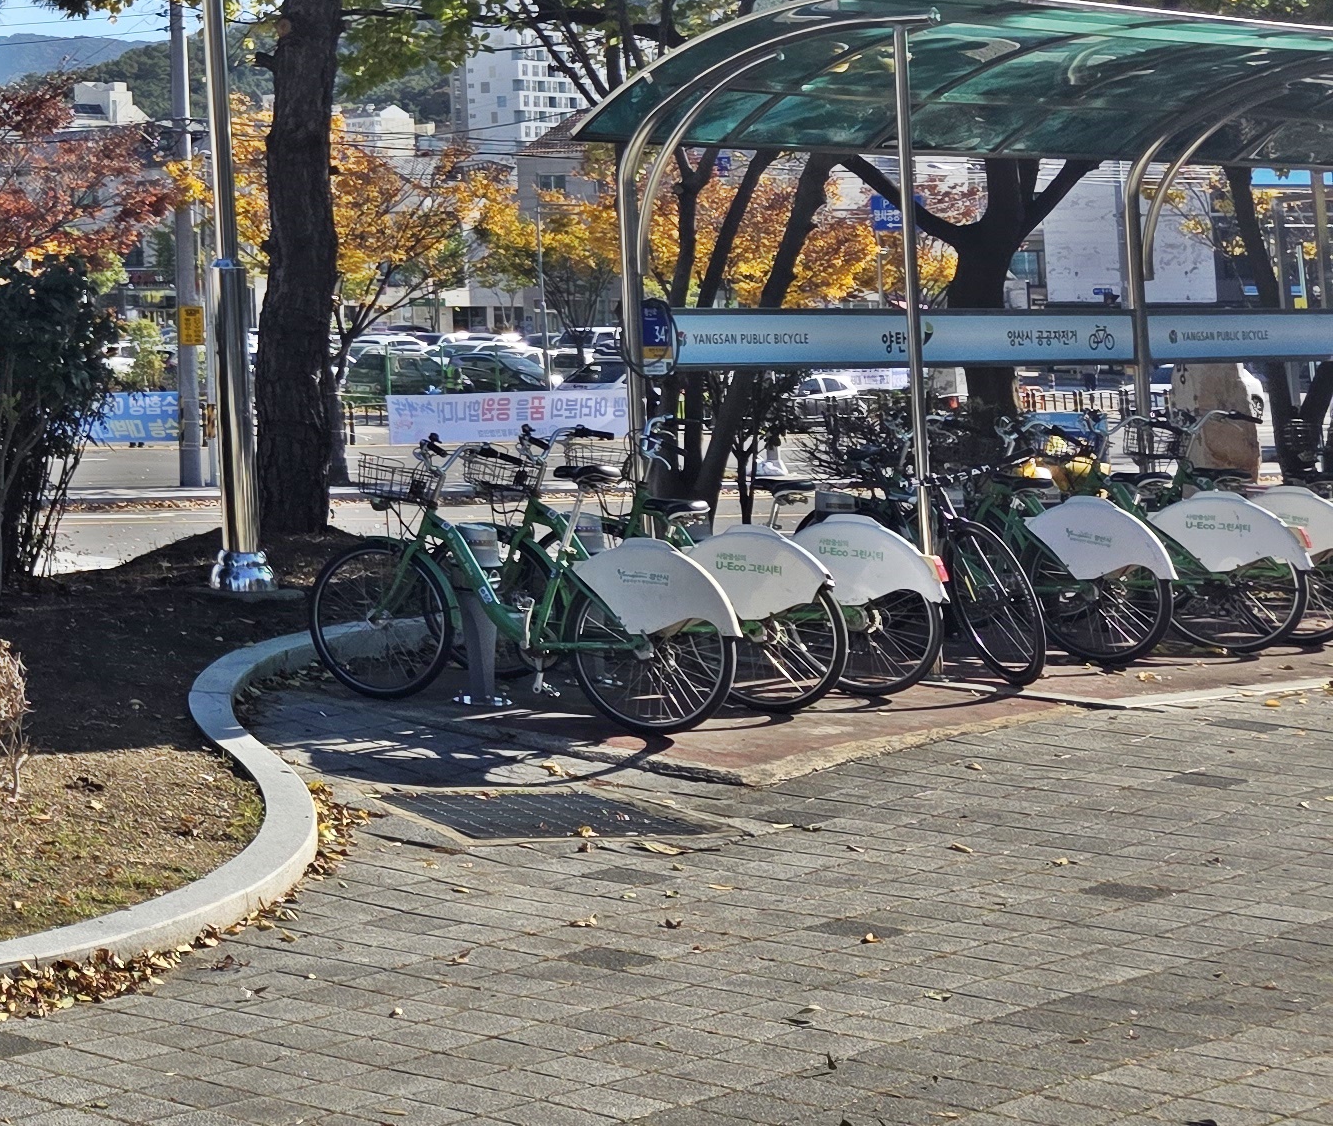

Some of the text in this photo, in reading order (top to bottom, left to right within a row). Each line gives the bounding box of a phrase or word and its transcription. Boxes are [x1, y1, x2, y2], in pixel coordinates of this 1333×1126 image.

[693, 332, 810, 345] YANGSAN PUBLIC BICYCLE
[1006, 329, 1079, 347] 양산시 공공자전거
[1181, 329, 1270, 342] YANGSAN PUBLIC BICYCLE
[1185, 521, 1251, 533] U-Eco 그린시티
[818, 545, 884, 561] U-Eco 그린시티
[716, 560, 783, 576] U-Eco 그린시티
